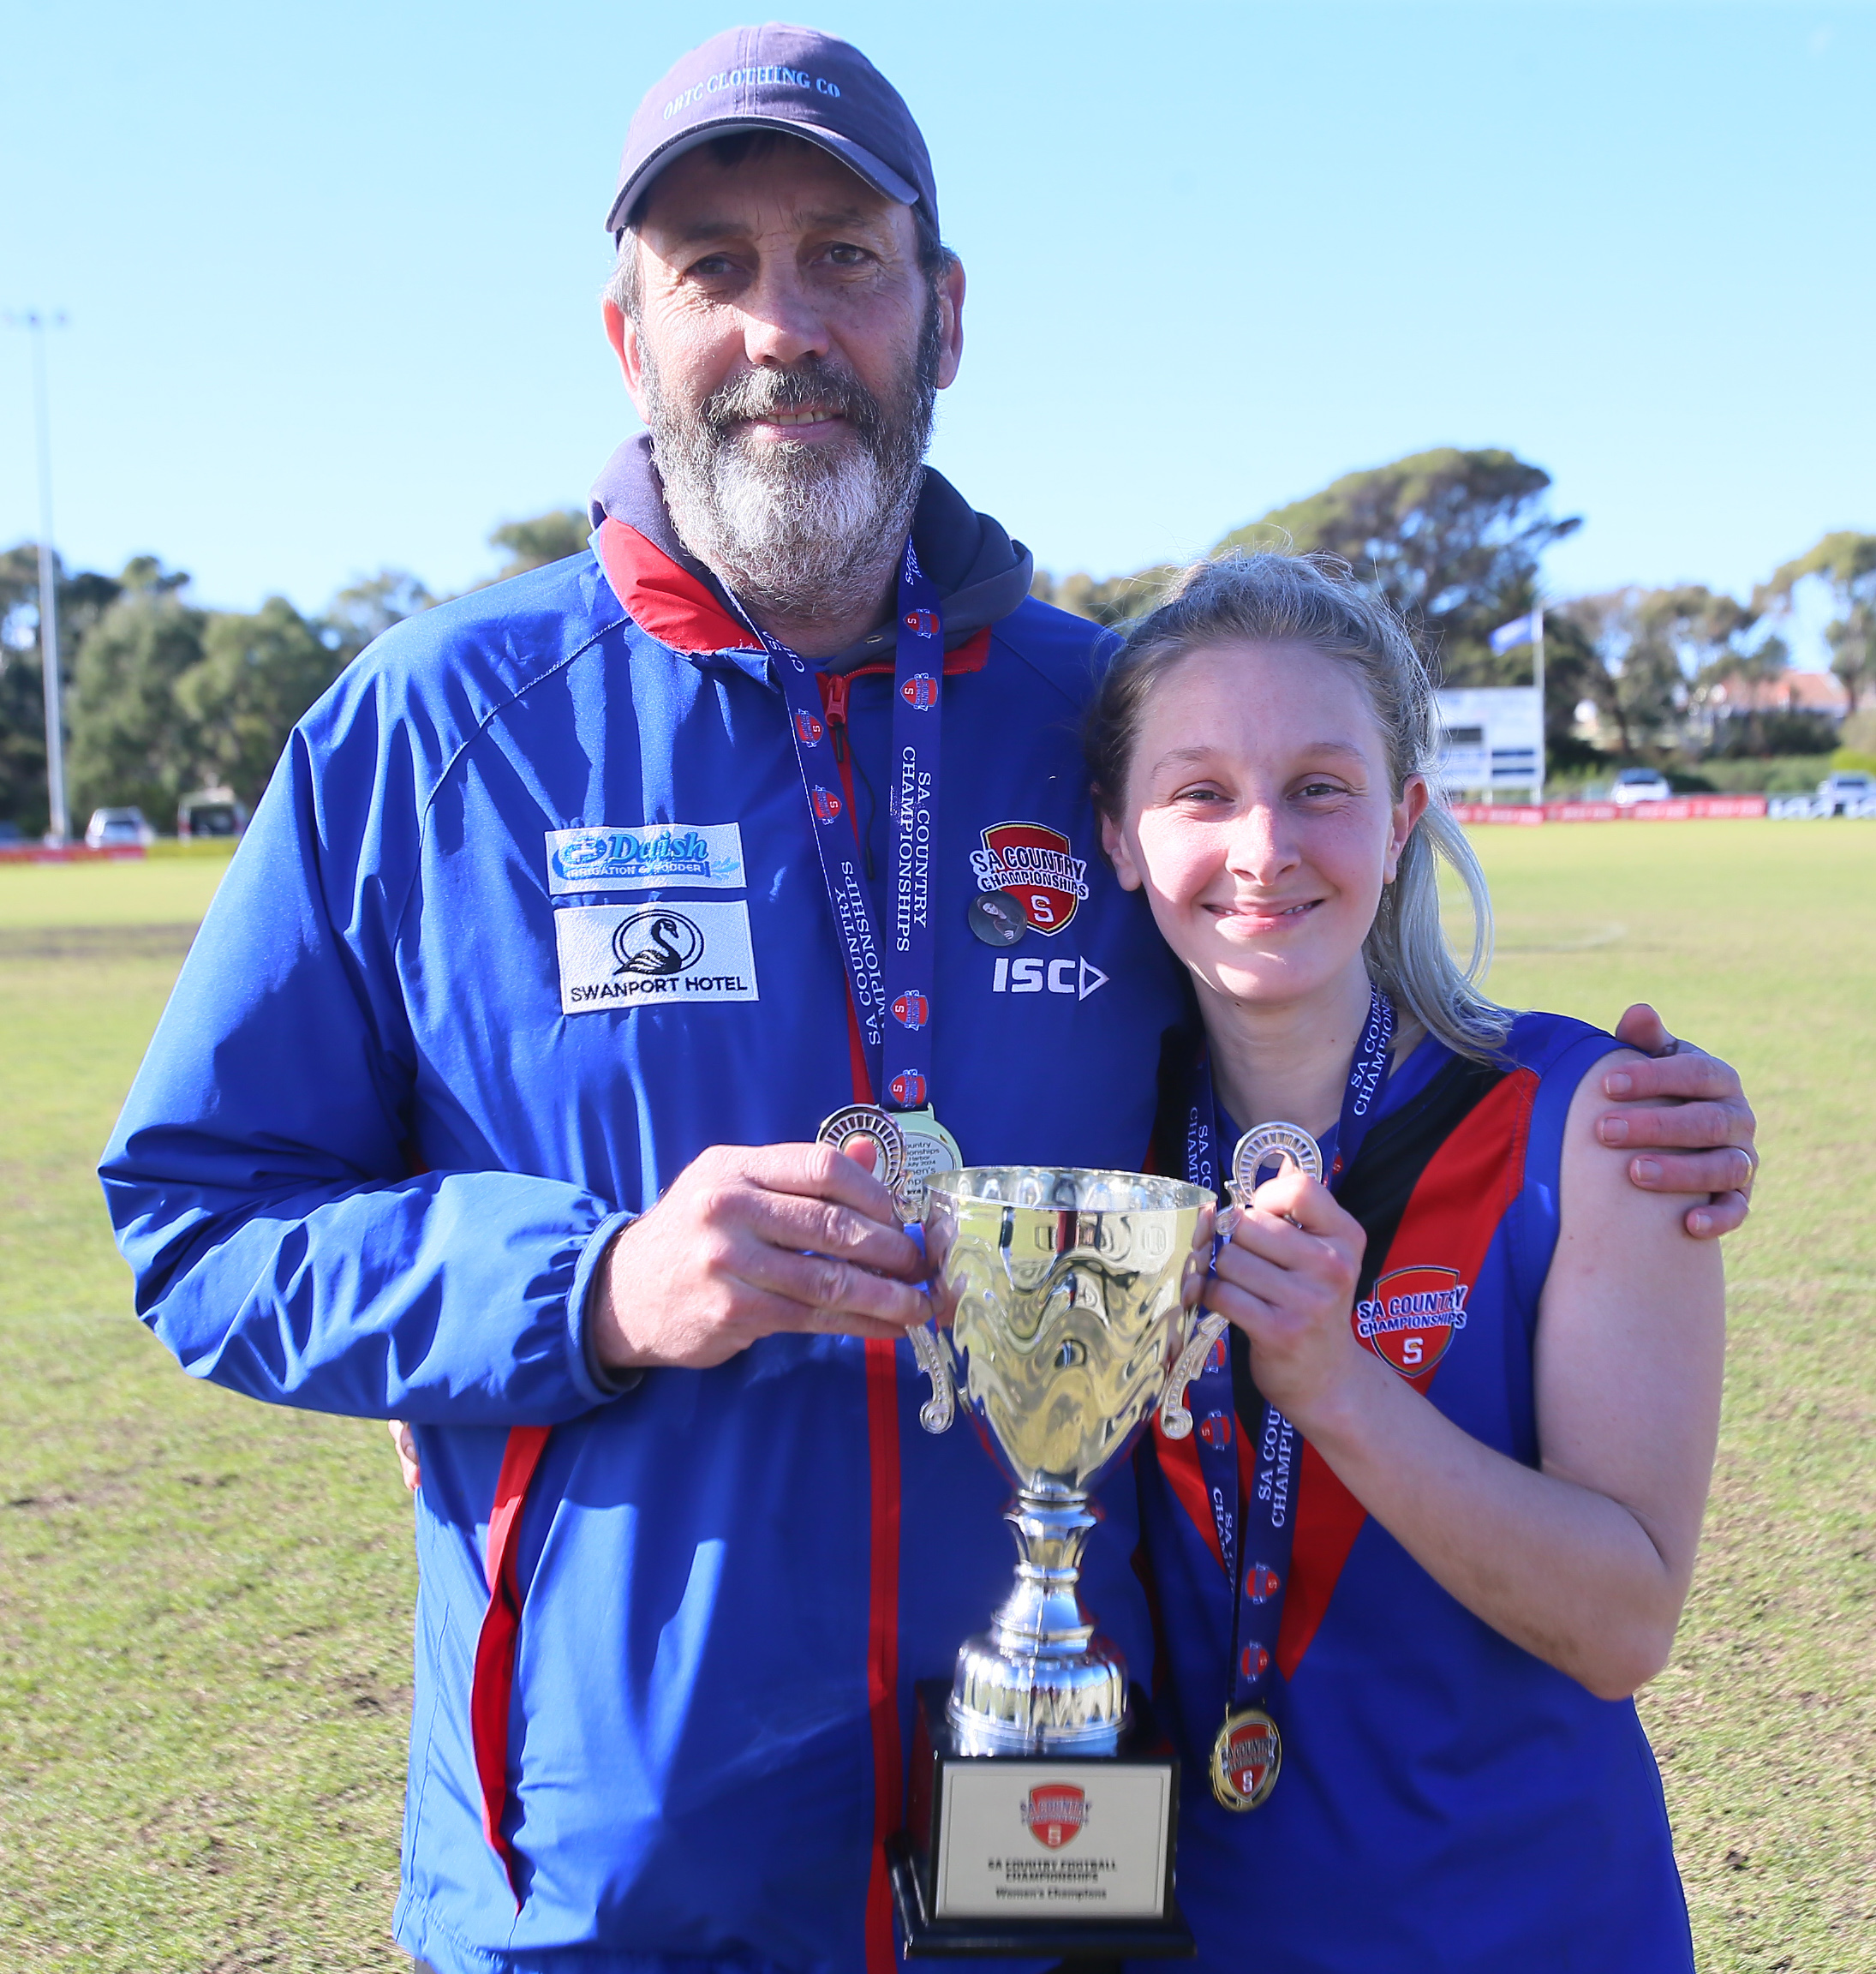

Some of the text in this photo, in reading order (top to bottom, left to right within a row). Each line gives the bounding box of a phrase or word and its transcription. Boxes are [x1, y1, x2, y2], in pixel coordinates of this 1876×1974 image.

[707, 65, 811, 93] CLOTHING
[816, 78, 842, 99] CO
[607, 831, 709, 863] Daish
[896, 745, 917, 952] CHAMPIONSHIPS
[913, 772, 932, 928] SA COUNTRY
[566, 864, 636, 879] IRRIGATION
[972, 846, 1086, 881] SA COUNTRY
[980, 869, 1088, 897] CHAMPIONSHIPS
[1031, 894, 1055, 923] S
[840, 861, 885, 1021] MPIONSHIPS
[834, 887, 881, 1045] SA COUNTRY
[993, 958, 1076, 993] ISC
[571, 976, 748, 1002] SWANPORT HOTEL
[1351, 1061, 1369, 1088] SA
[906, 1141, 931, 1150] ountry
[907, 1148, 940, 1157] ionships
[1198, 1125, 1209, 1155] SA
[1358, 1285, 1468, 1321] SA COUNTRY
[1359, 1313, 1467, 1337] CHAMPIONSHIPS
[1402, 1337, 1424, 1364] S
[1258, 1469, 1274, 1500] SA
[988, 1857, 1117, 1872] SA COUNTRY FOOTBALL
[1006, 1871, 1099, 1883] CHAMPIONSHIPS
[995, 1887, 1108, 1902] Women's Champions
